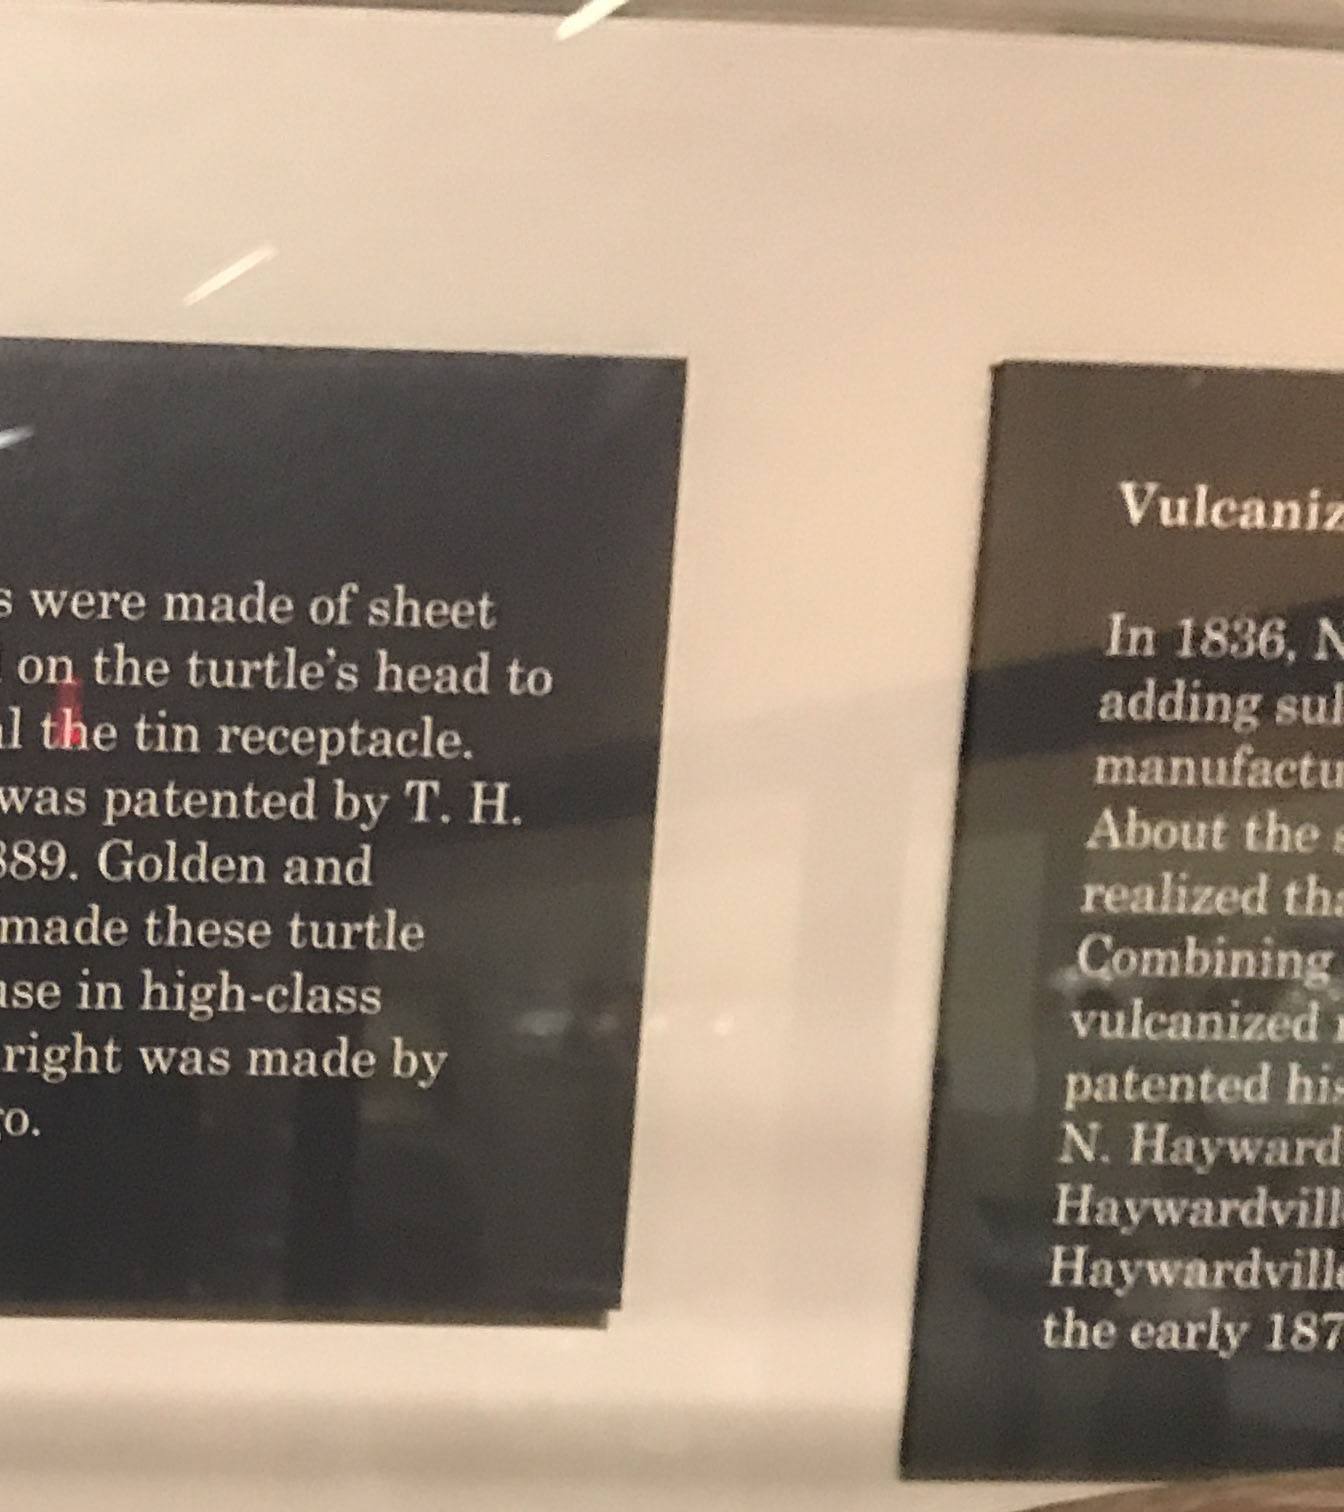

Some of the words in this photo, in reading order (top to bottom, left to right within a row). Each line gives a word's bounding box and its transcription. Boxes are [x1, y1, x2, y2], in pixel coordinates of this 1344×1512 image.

[28, 587, 148, 622] were
[162, 578, 295, 626] made
[308, 580, 360, 627] of
[366, 582, 497, 631] sheet
[1104, 611, 1157, 658] In
[1175, 616, 1298, 666] 1836,
[16, 653, 79, 687] on
[92, 640, 172, 688] the
[186, 644, 360, 693] turtle's
[374, 647, 491, 696] head
[506, 656, 554, 698] to
[1097, 675, 1264, 734] adding
[39, 705, 119, 753] the
[133, 708, 202, 754] tin
[216, 713, 474, 767] receptacle.
[101, 776, 318, 828] patented
[331, 776, 391, 833] by
[402, 778, 452, 825] T.
[468, 780, 523, 826] H.
[1084, 805, 1228, 853] About
[1244, 808, 1321, 854] the
[96, 837, 268, 885] Golden
[281, 842, 374, 888] and
[1079, 870, 1270, 917] realized
[143, 902, 274, 950] these
[287, 907, 426, 953] turtle
[1074, 932, 1336, 989] Combining
[75, 966, 124, 1011] in
[139, 966, 383, 1023] high-class
[1068, 996, 1320, 1043] vulcanized
[1, 1029, 123, 1085] right
[137, 1045, 232, 1077] was
[245, 1034, 378, 1079] made
[391, 1034, 450, 1090] by
[1063, 1060, 1272, 1113] patented
[1056, 1120, 1111, 1165] N.
[1052, 1181, 1344, 1234] Haywardvill
[1042, 1305, 1118, 1351] the
[1129, 1306, 1251, 1361] early
